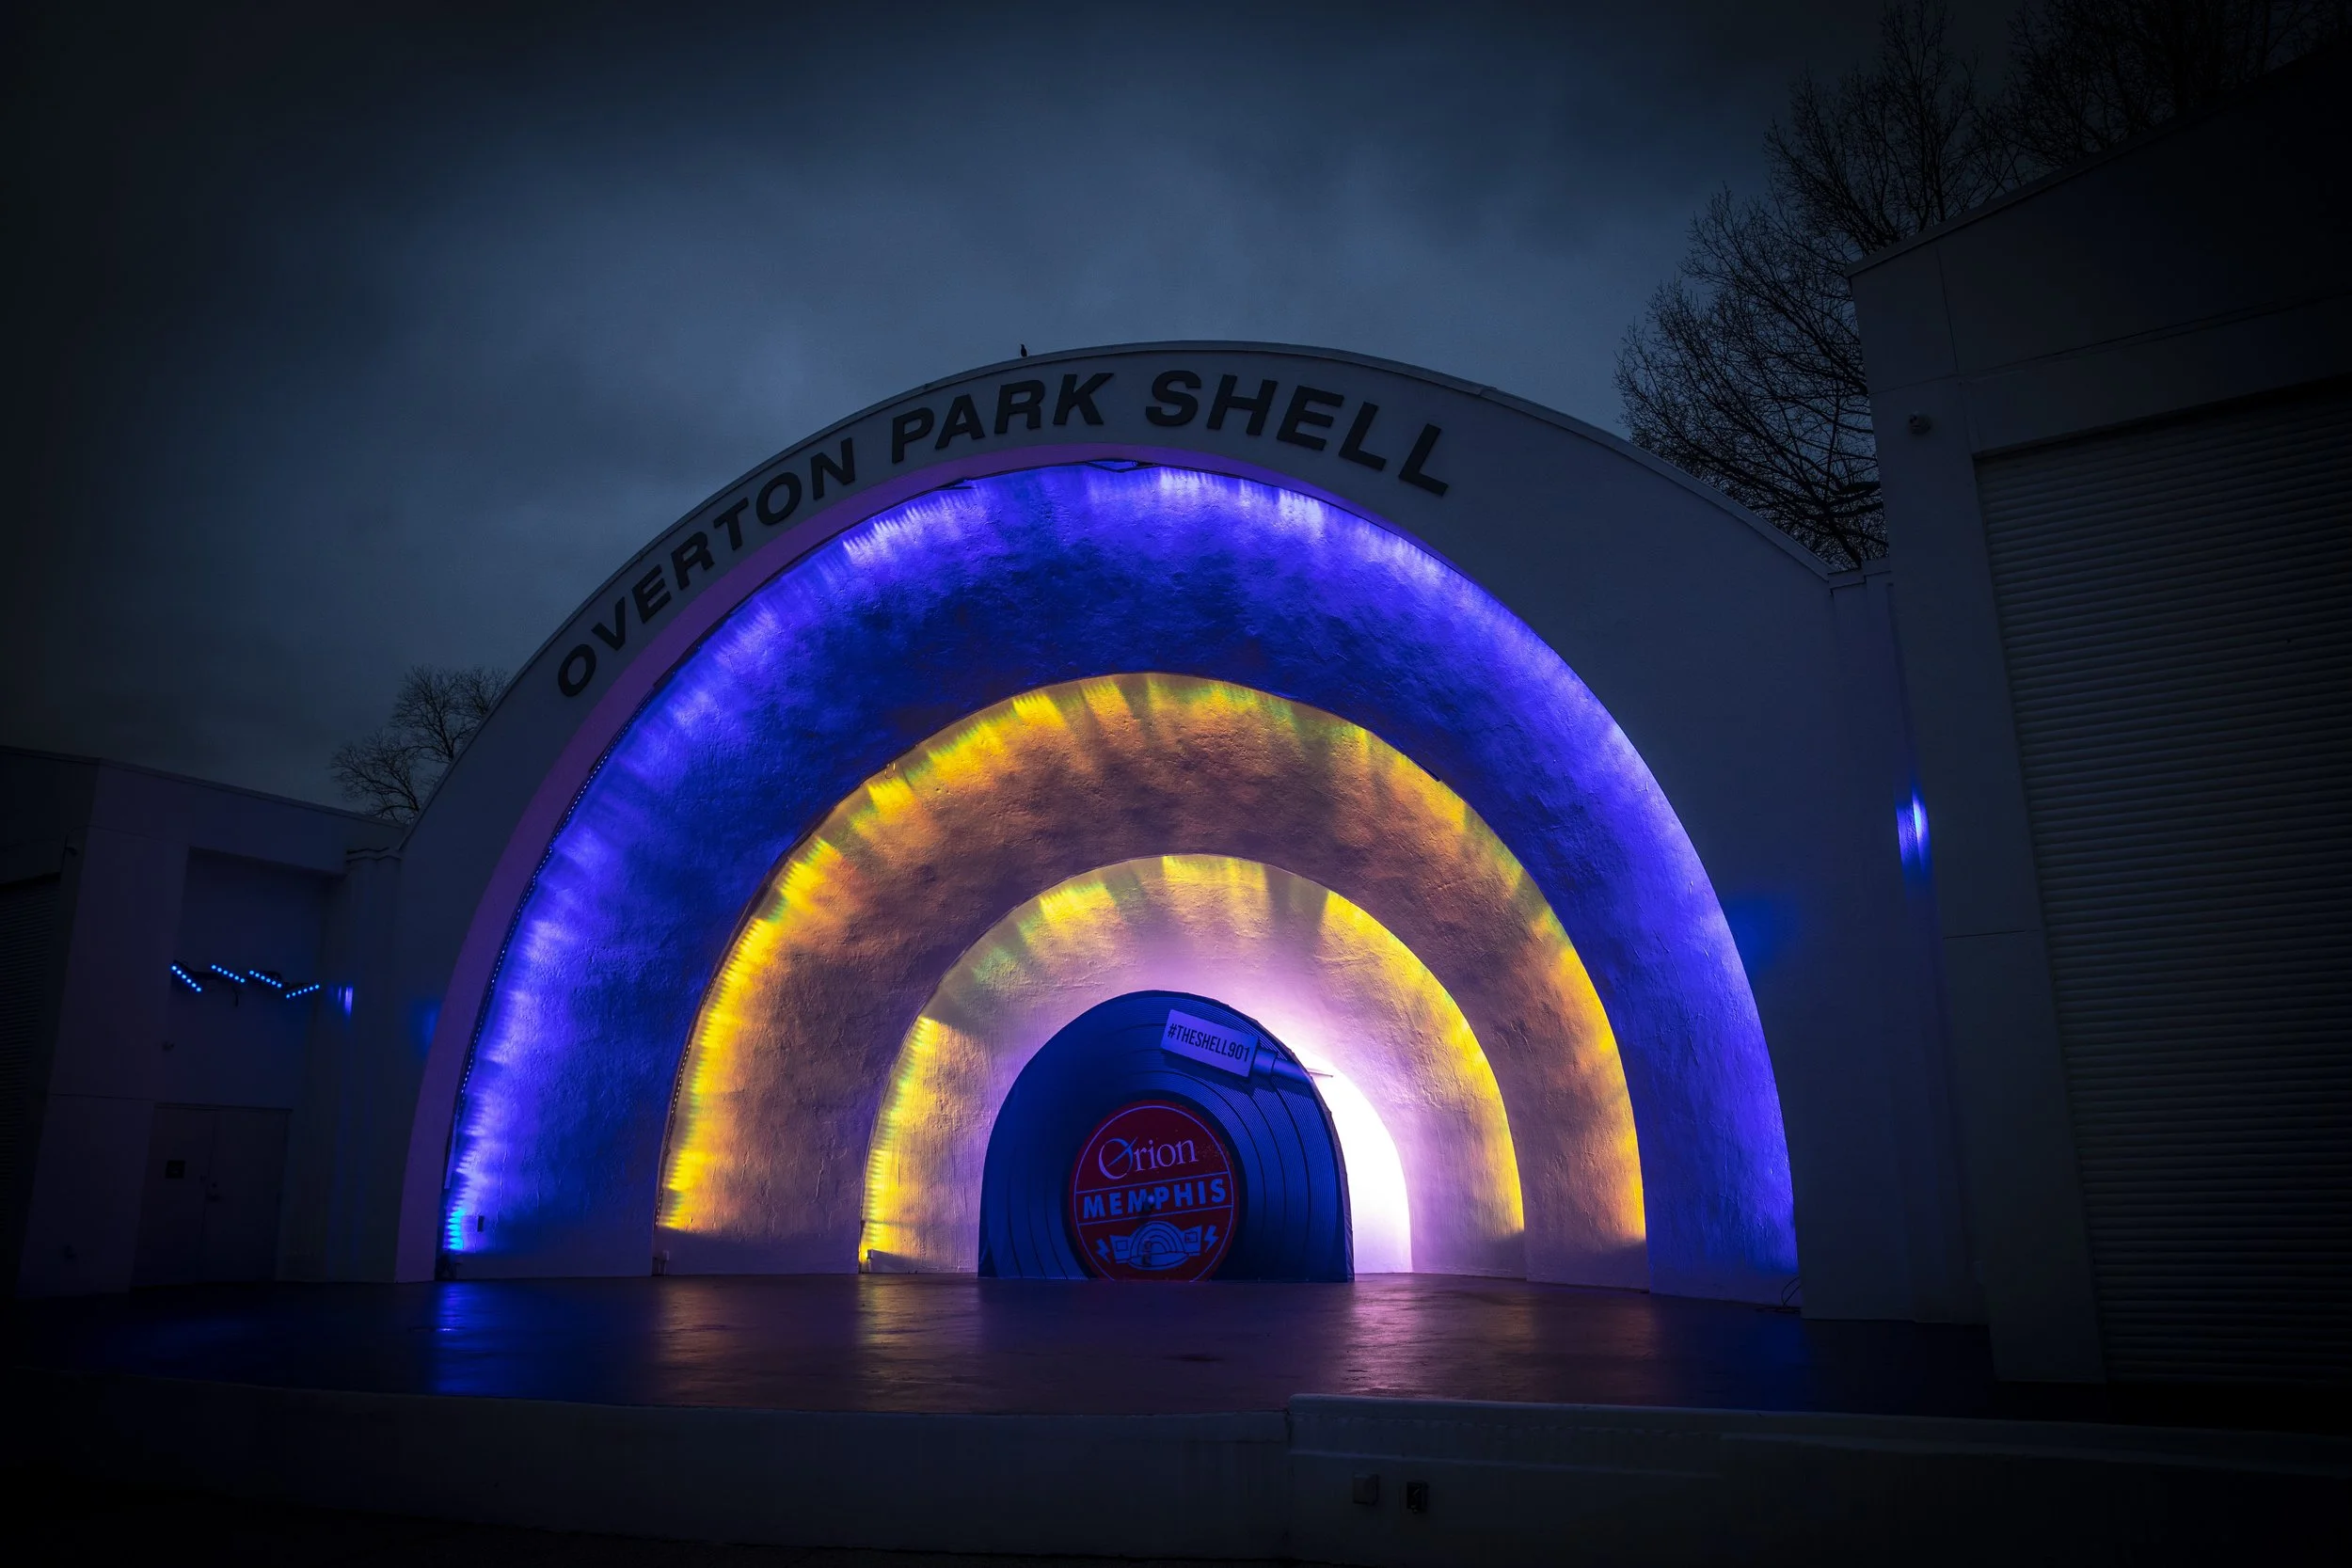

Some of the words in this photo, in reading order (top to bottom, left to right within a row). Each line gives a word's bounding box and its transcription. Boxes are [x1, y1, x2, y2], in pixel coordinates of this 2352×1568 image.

[558, 436, 856, 697] OVERTON
[891, 372, 1114, 464] PARK
[1145, 370, 1450, 498] SHELL
[1168, 1023, 1250, 1062] #THESHELL901
[1098, 1136, 1199, 1180] Orion
[1083, 1179, 1227, 1219] MEMPHIS
